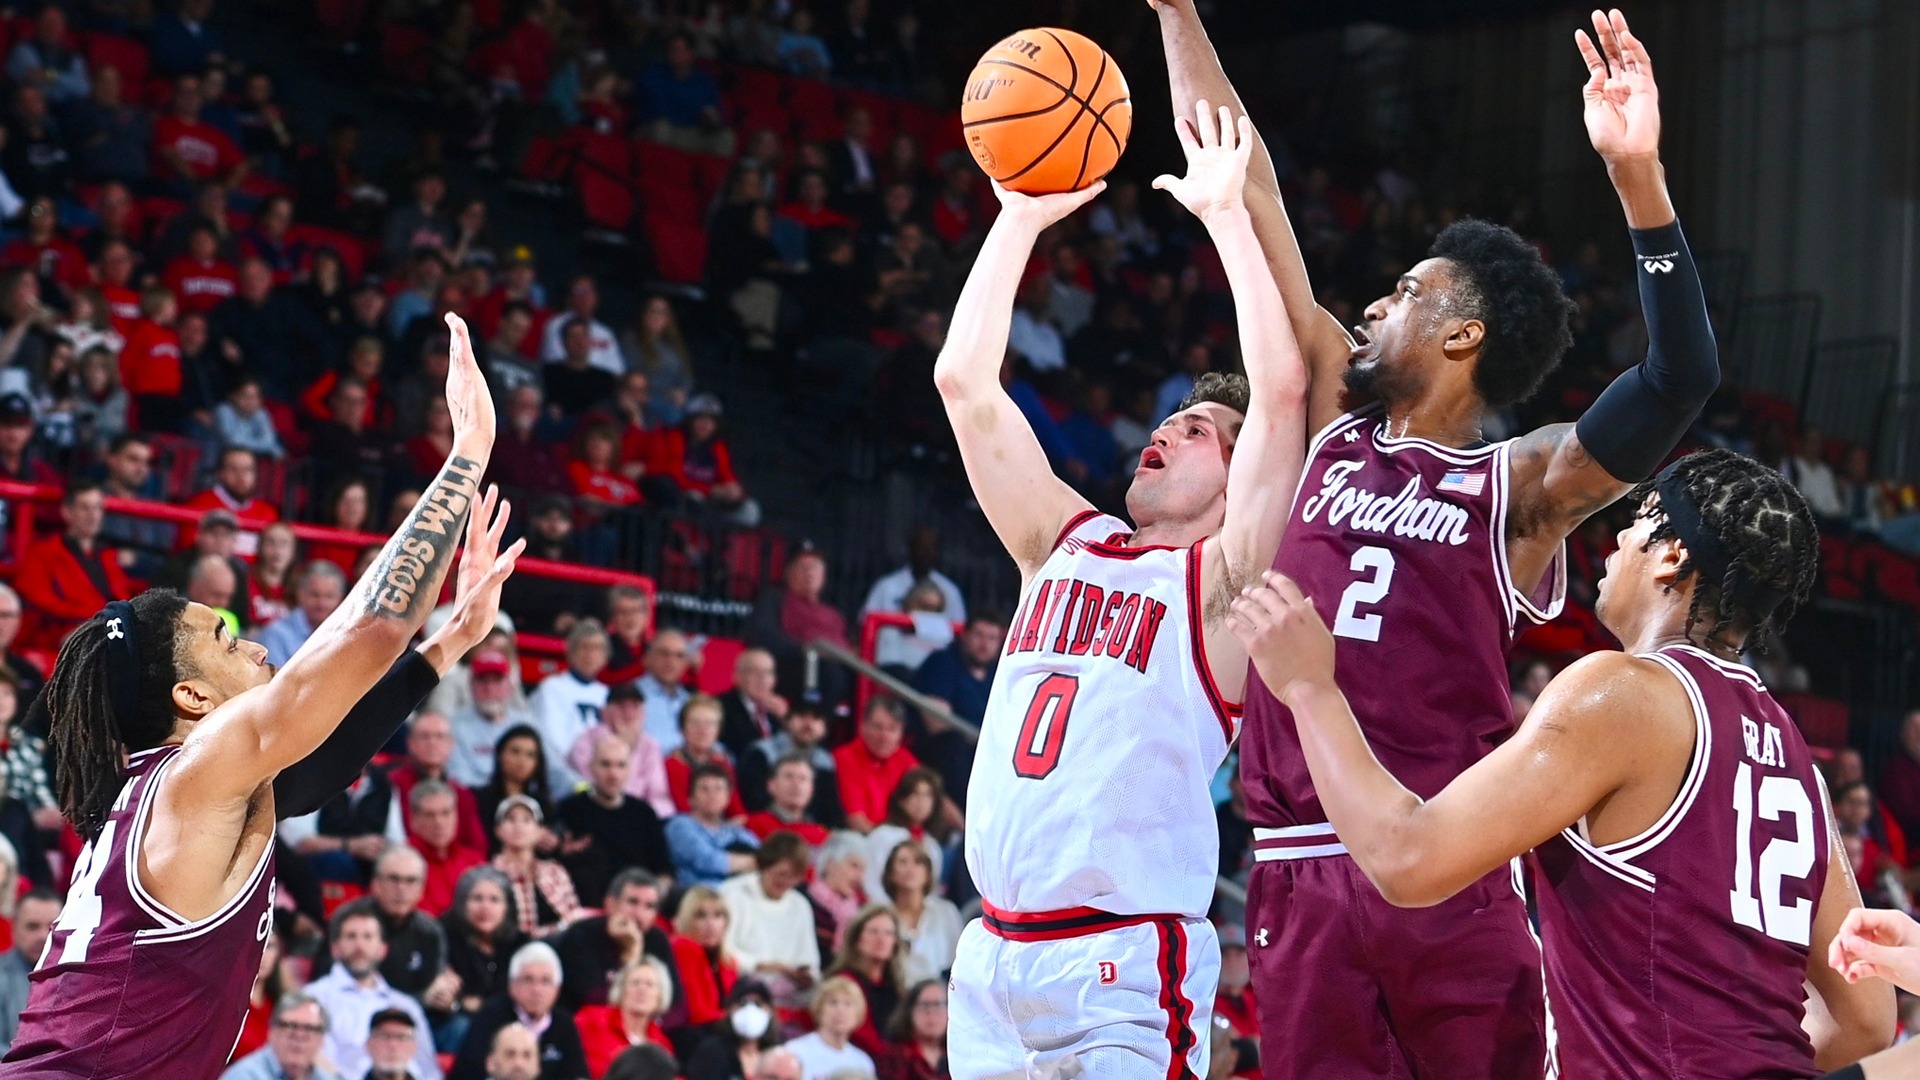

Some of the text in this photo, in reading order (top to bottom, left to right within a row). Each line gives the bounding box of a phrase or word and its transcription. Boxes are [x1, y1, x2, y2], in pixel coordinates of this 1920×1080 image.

[378, 462, 481, 613] GODS WILL
[1302, 460, 1469, 545] Fordham
[1007, 579, 1167, 674] DAVIDSON
[1333, 545, 1395, 642] 2
[1012, 673, 1079, 780] 0
[1741, 714, 1786, 768] GRAY
[1730, 760, 1816, 947] 12
